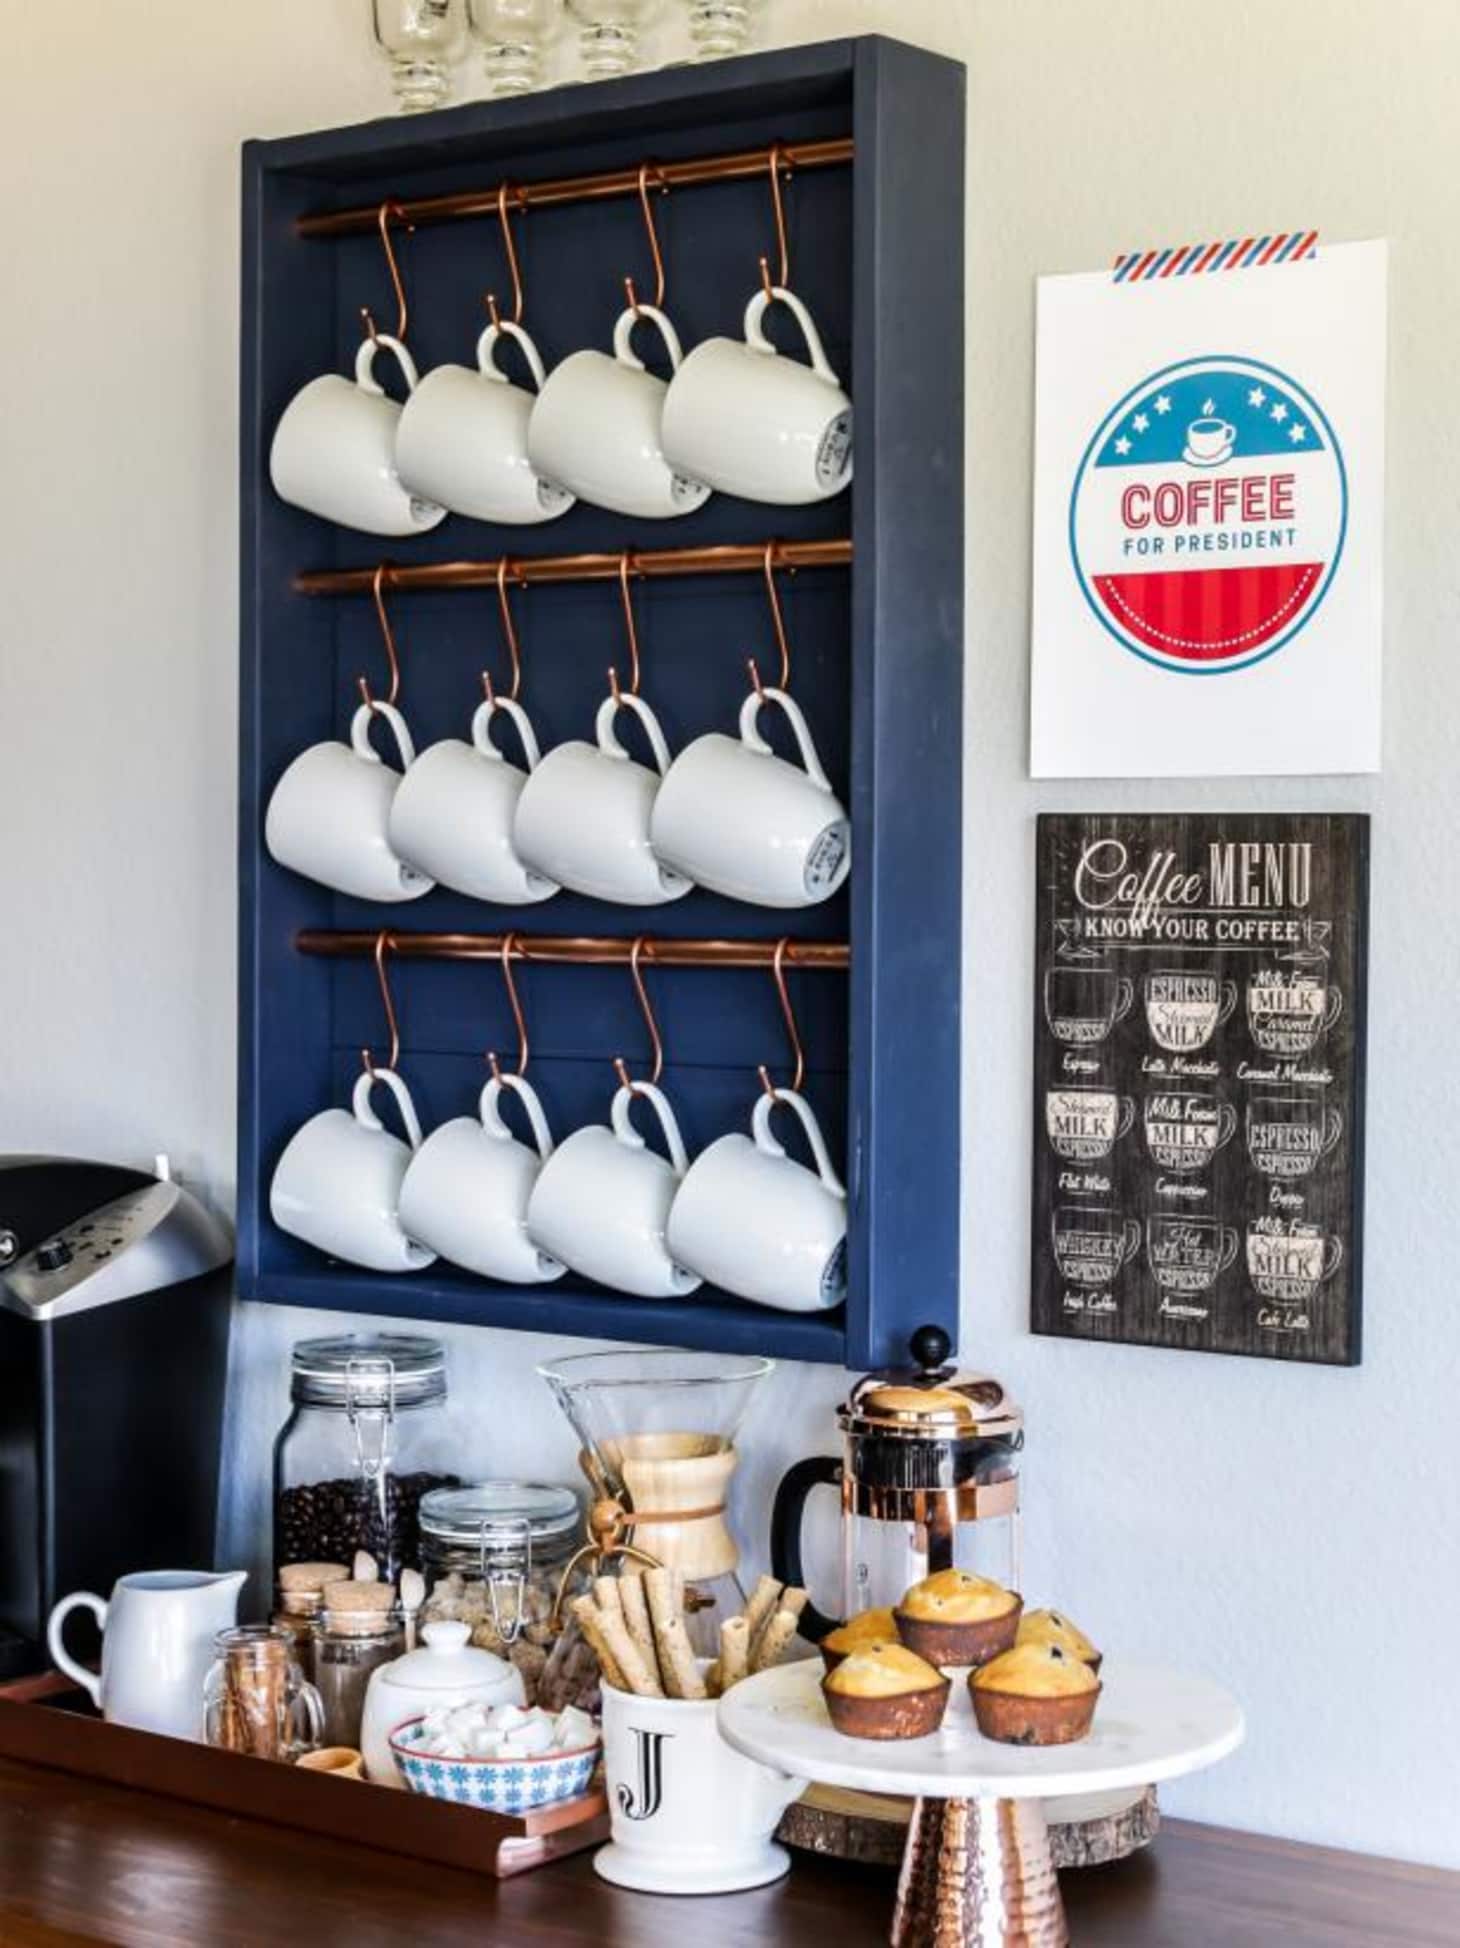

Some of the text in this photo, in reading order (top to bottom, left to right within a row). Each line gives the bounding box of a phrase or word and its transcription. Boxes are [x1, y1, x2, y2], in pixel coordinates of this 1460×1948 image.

[1121, 473, 1296, 530] COFFEE
[1123, 528, 1296, 556] FOR PRESIDENT
[1074, 838, 1312, 930] Coffee MENU
[1085, 917, 1301, 943] KNOW YOUR COFFEE
[1256, 989, 1314, 1011] MILK
[1055, 1115, 1107, 1136] MILK
[1153, 1125, 1208, 1146] MILK
[1256, 1254, 1313, 1278] MILK
[616, 1727, 675, 1820] J
